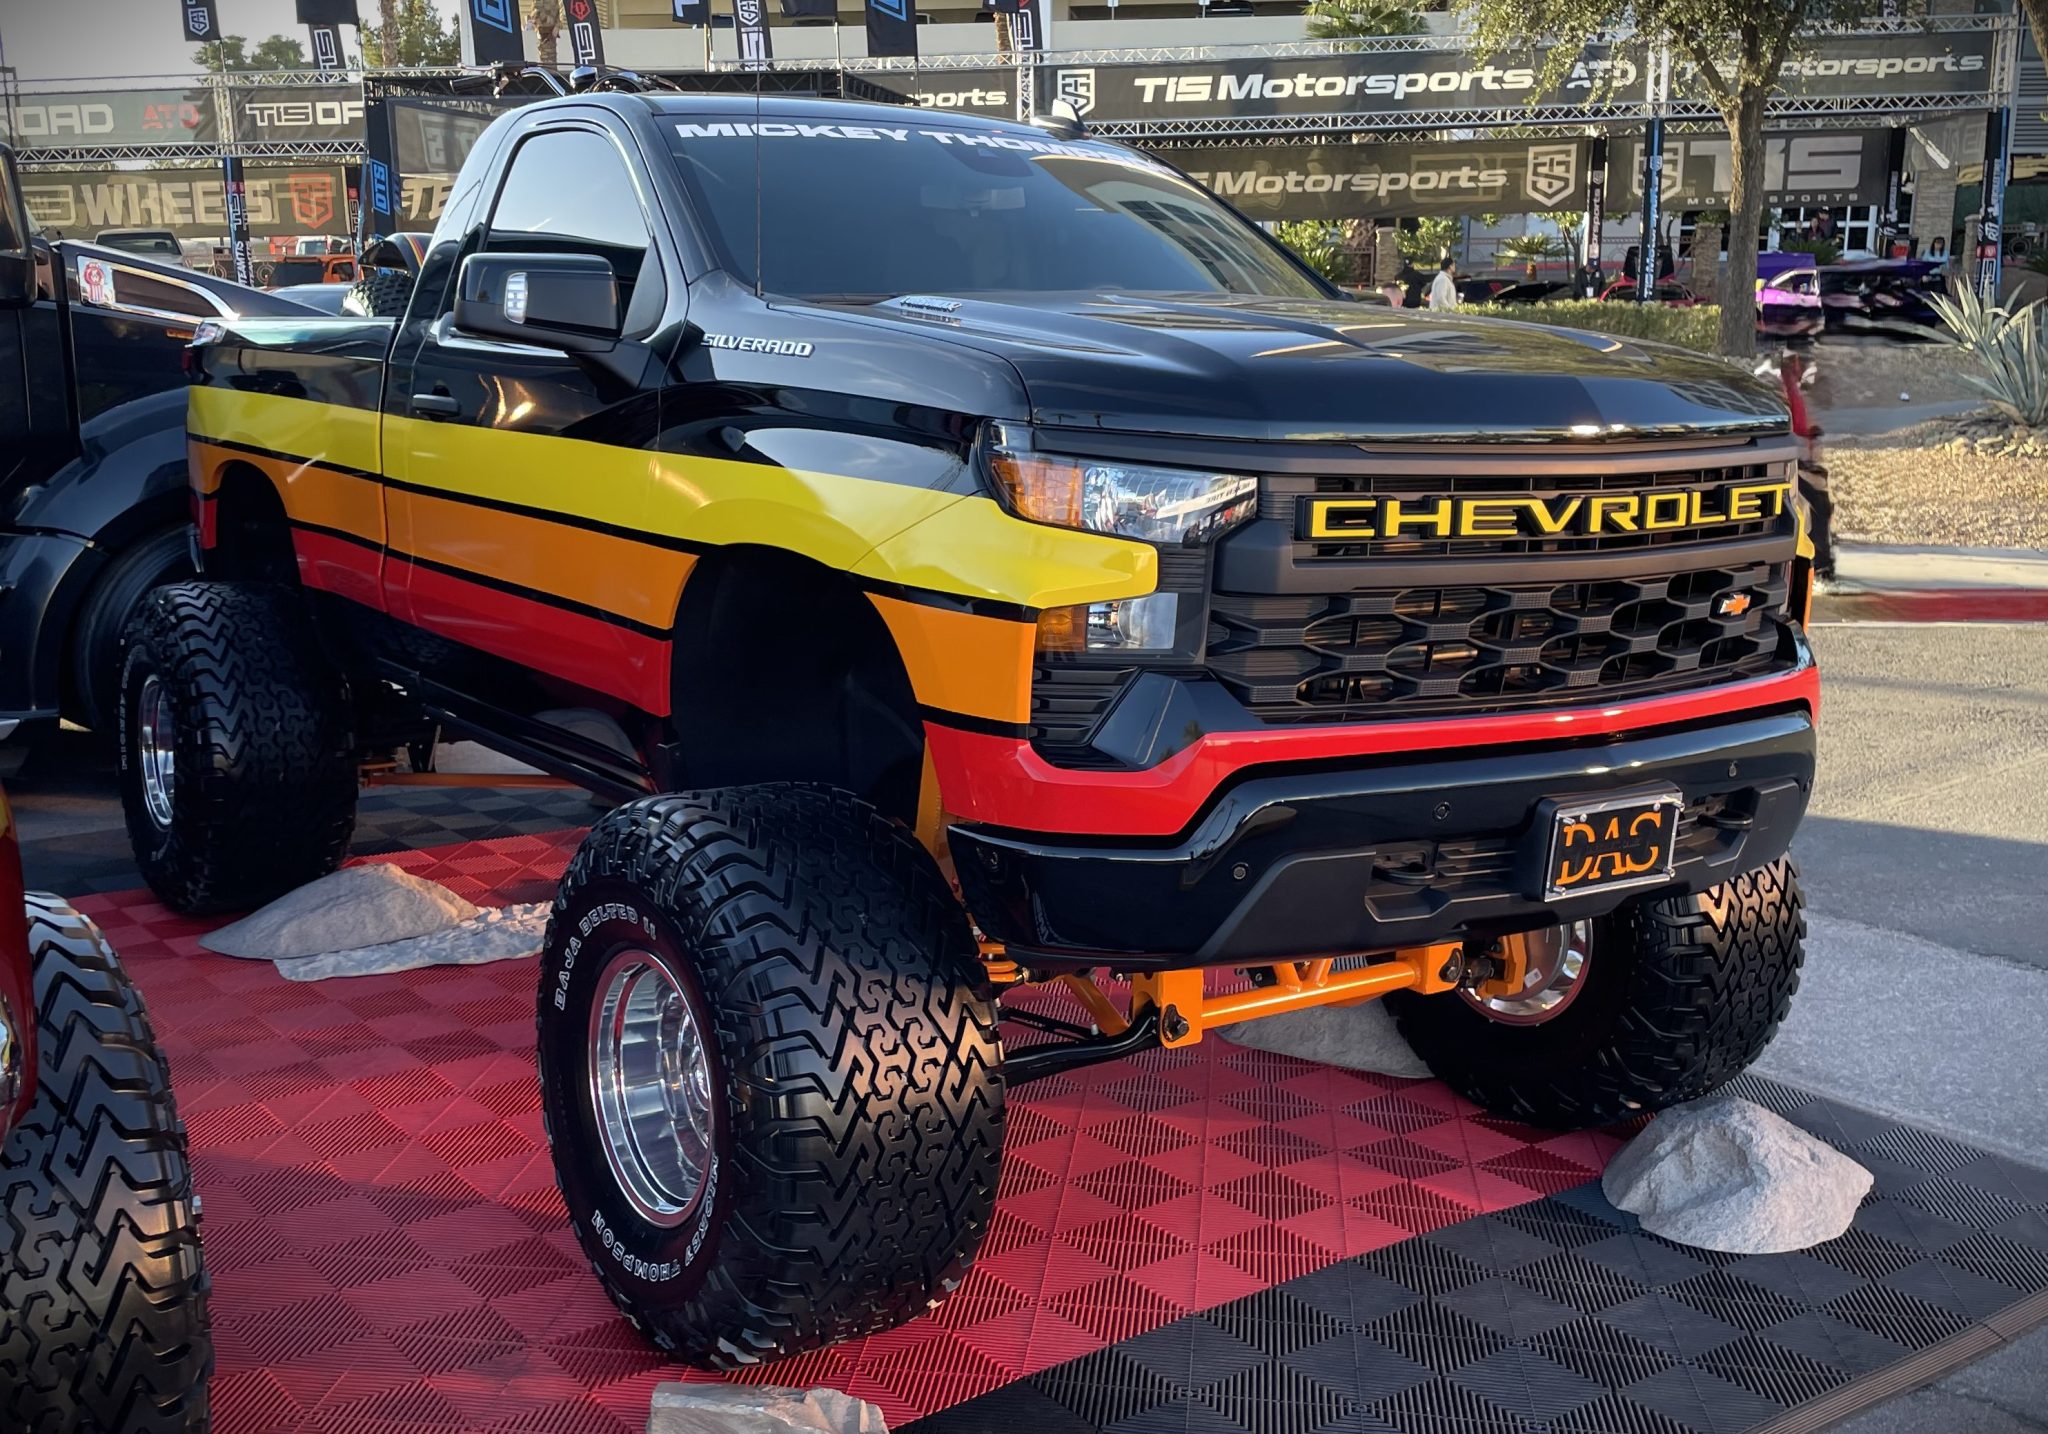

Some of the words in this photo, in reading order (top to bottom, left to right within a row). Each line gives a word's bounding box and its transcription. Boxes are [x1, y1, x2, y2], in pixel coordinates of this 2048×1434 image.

[1778, 53, 1983, 79] otorsports
[907, 88, 1007, 108] ports
[1134, 75, 1212, 102] TIS
[1218, 66, 1535, 101] Motorsports
[245, 102, 313, 126] TIS
[675, 123, 909, 141] MICKEY
[1690, 136, 1863, 193] TIS
[1213, 166, 1508, 196] Motorsports
[81, 181, 274, 225] WHEES
[1687, 193, 1859, 206] MOTSPORTS
[702, 332, 815, 358] SILVERADO
[1310, 483, 1792, 537] CHEVROLET
[555, 937, 582, 1011] BAJA
[579, 903, 639, 937] BELTED
[591, 1209, 681, 1282] THOMPSON
